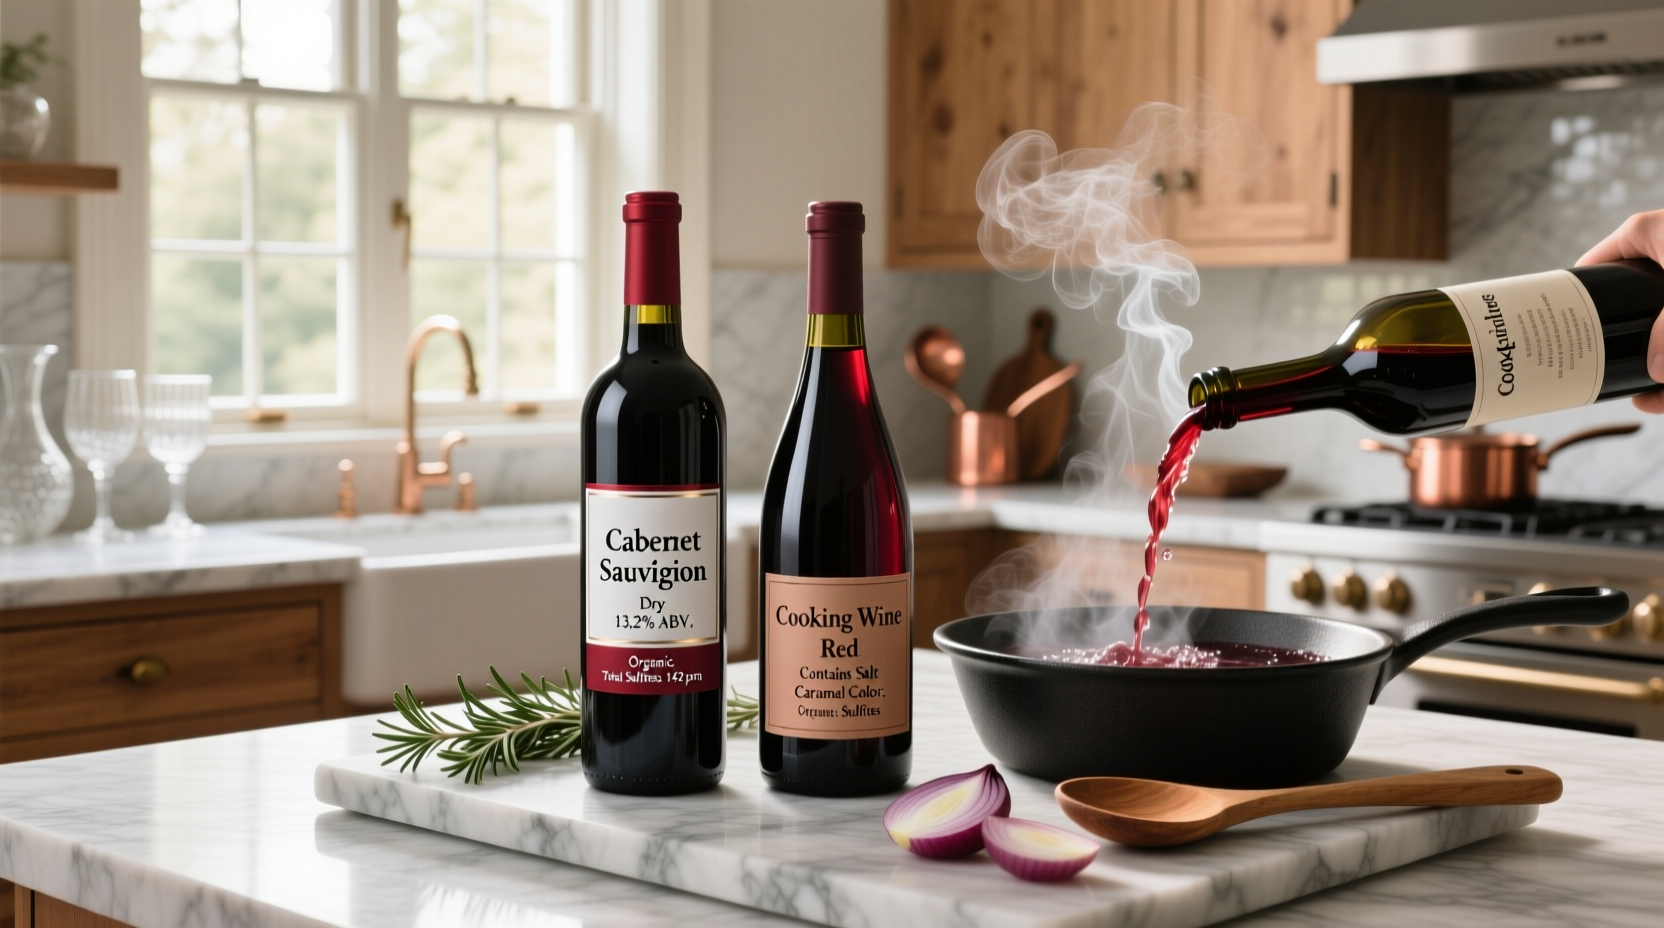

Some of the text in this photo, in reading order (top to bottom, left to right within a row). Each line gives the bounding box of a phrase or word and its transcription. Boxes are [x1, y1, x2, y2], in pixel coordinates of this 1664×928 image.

[600, 558, 707, 591] Sauvigion
[639, 596, 666, 614] Dry
[776, 605, 902, 634] Cooking Wine
[820, 638, 859, 658] Red
[799, 666, 852, 680] Contains
